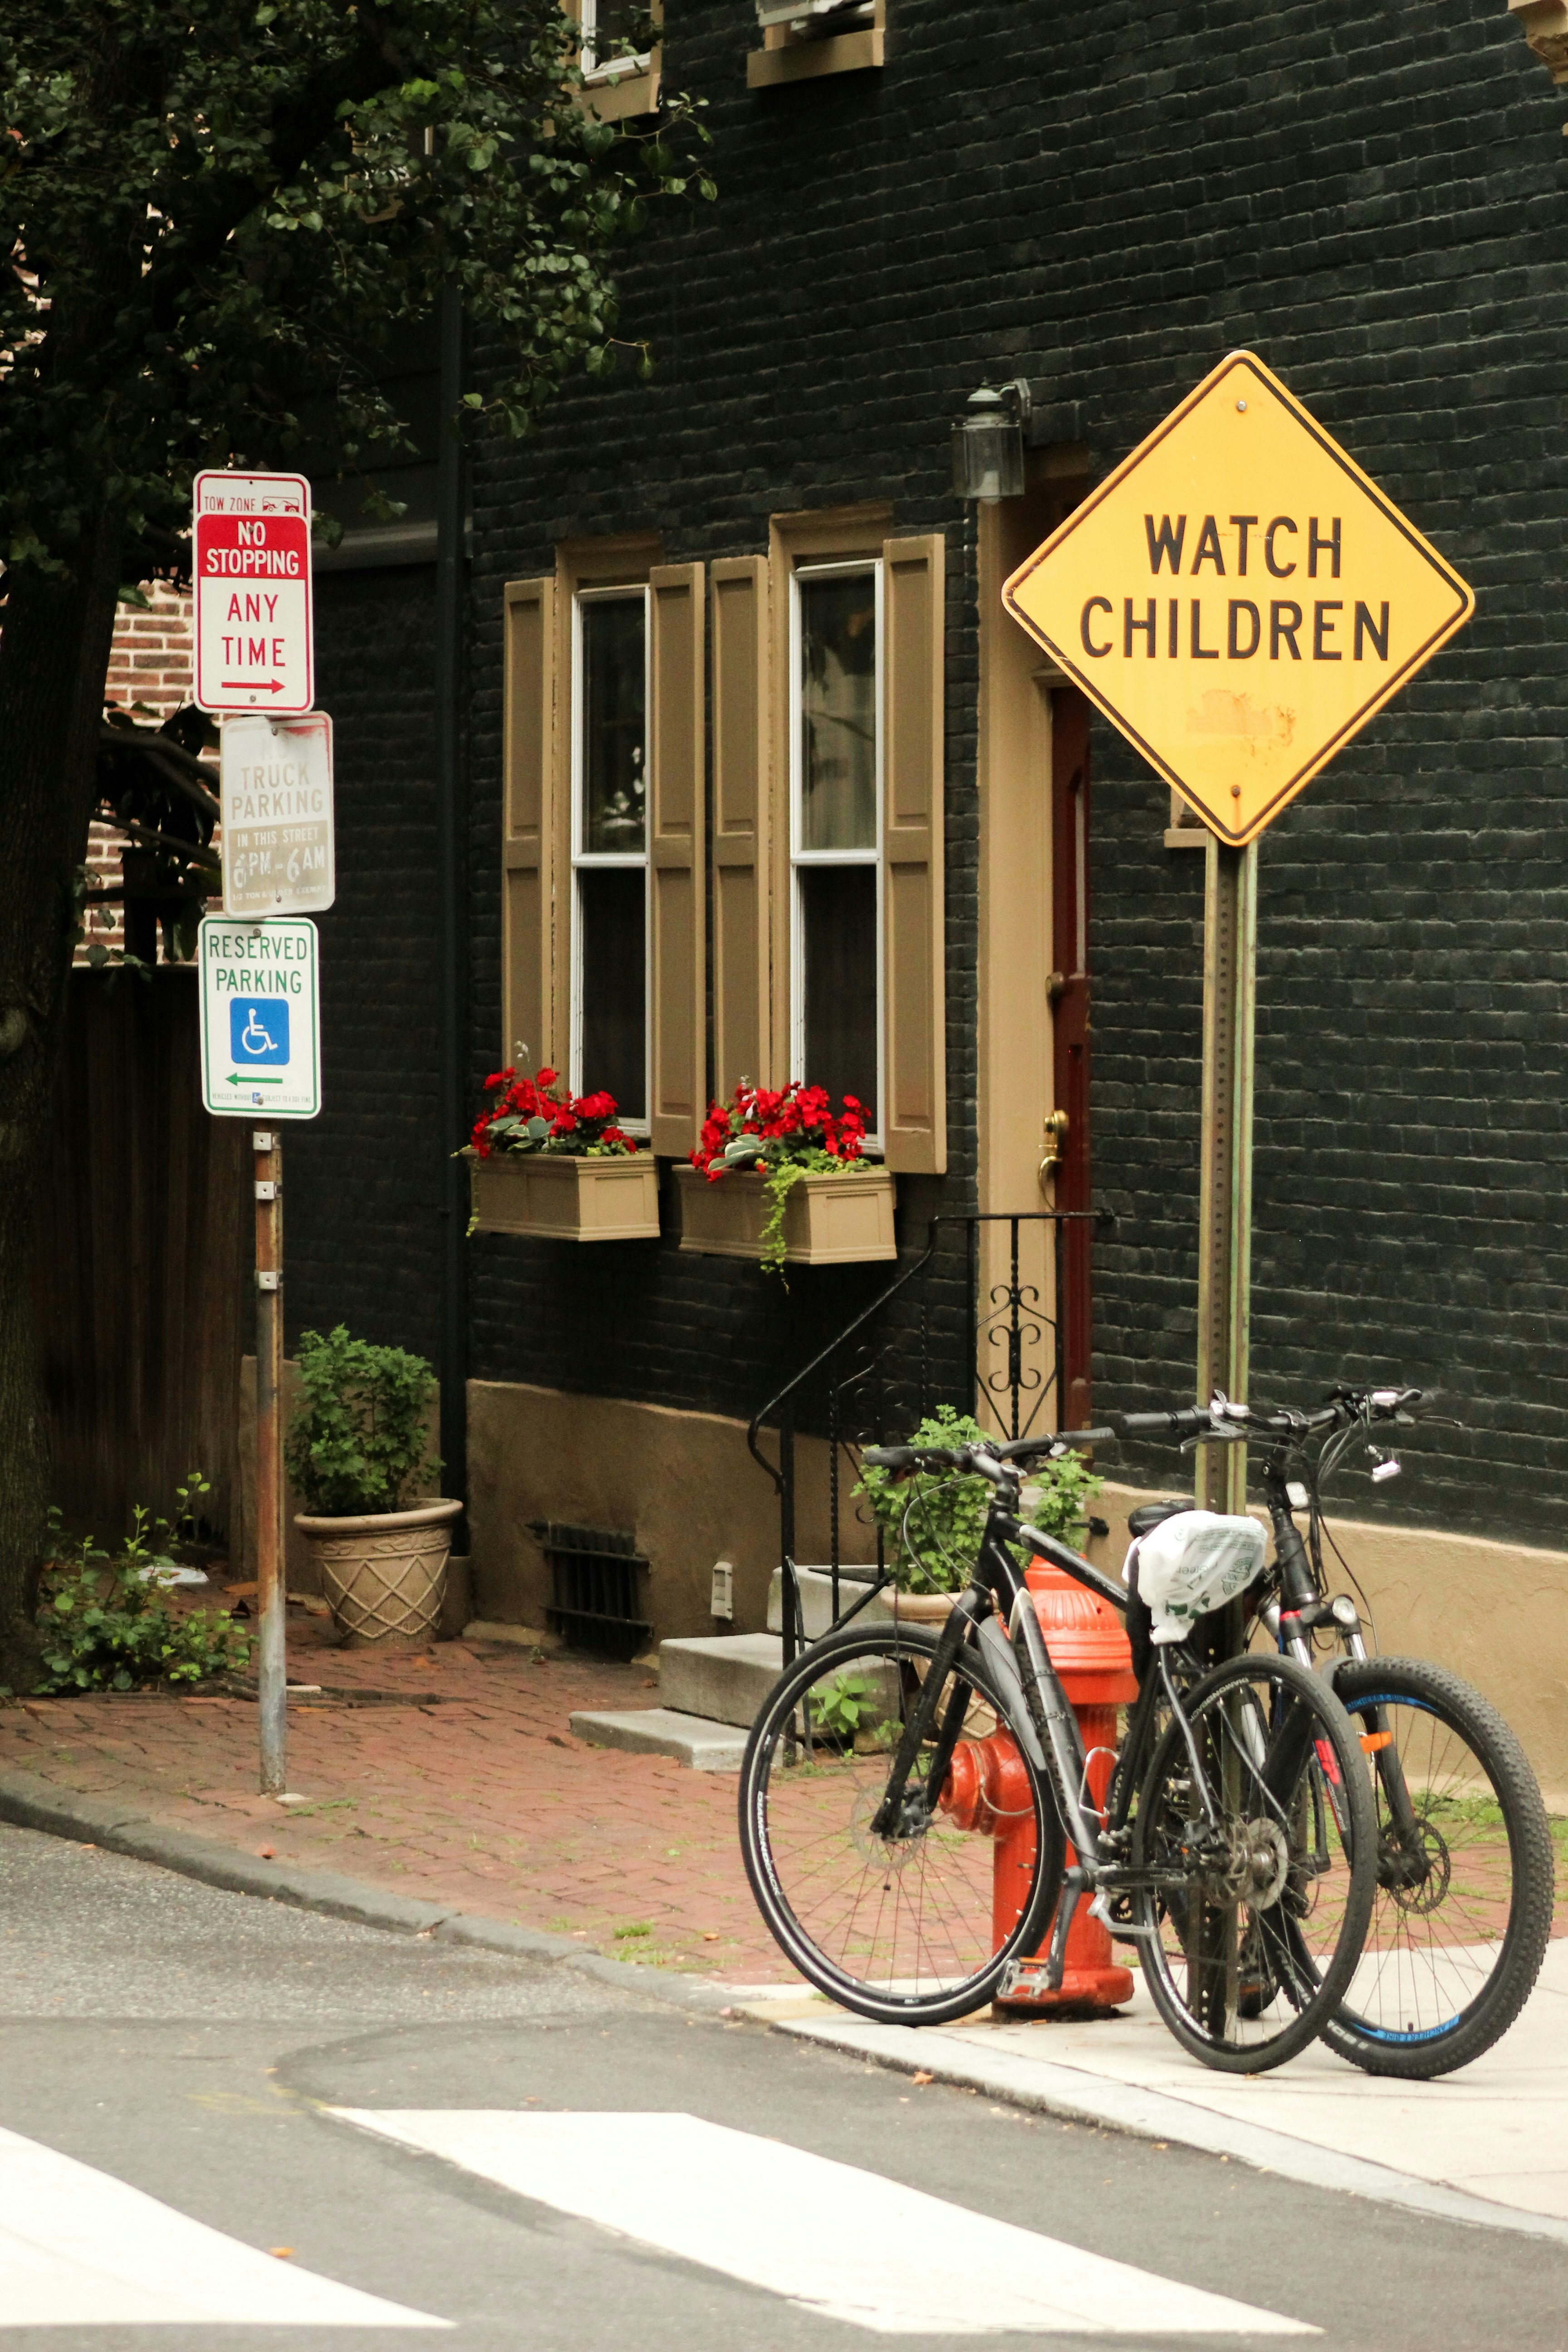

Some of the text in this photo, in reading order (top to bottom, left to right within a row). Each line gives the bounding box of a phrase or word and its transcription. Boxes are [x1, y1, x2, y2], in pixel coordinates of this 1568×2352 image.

[205, 496, 255, 511] TOW ZONE
[238, 521, 266, 546] NO
[1144, 514, 1341, 578] WATCH
[206, 548, 299, 575] STOPPING
[227, 593, 278, 622] ANY
[1080, 596, 1390, 662] CHILDREN
[221, 637, 285, 666] TIME
[241, 761, 310, 790] TRUCK
[232, 789, 323, 820] PARKING
[237, 827, 318, 848] IN THIS STREET
[233, 849, 271, 889] 6PM
[287, 845, 325, 882] 6AM
[209, 935, 307, 960] RESERVED
[216, 968, 302, 994] PARKING
[757, 1791, 782, 1896] DIAMONDBACK
[1161, 1973, 1213, 2040] DIAMONDBACK
